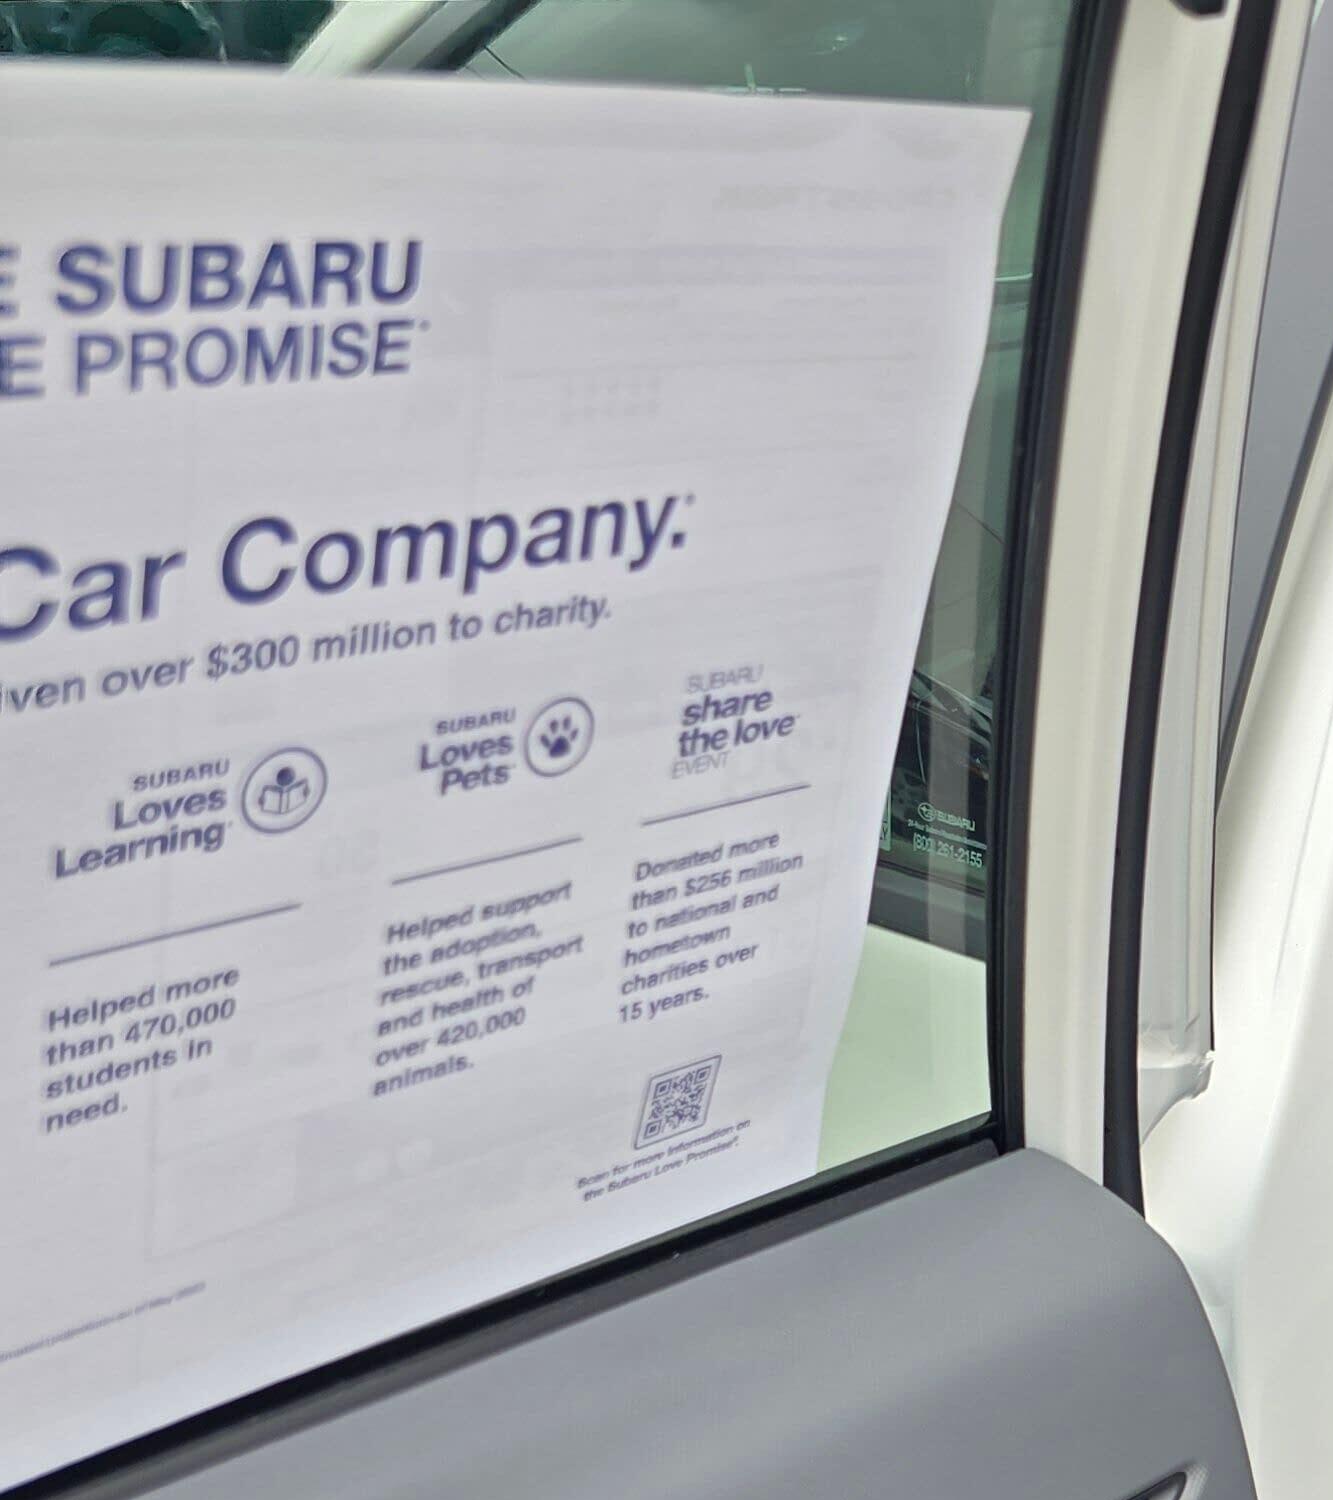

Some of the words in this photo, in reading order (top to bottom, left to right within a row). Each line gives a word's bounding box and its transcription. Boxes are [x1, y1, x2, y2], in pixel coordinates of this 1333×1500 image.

[56, 239, 423, 316] SUBARU
[75, 318, 415, 396] PROMISE
[0, 545, 187, 643] Car
[221, 497, 688, 605] Company.
[0, 676, 86, 714] ven
[102, 657, 194, 697] over
[207, 636, 301, 680] $300
[312, 618, 436, 661] million
[449, 610, 483, 642] to
[494, 596, 612, 635] charity.
[687, 665, 764, 694] SUBARU
[436, 708, 517, 736] SUBARU
[682, 690, 774, 727] share
[419, 734, 513, 772] Loves
[678, 727, 726, 758] the
[734, 714, 796, 747] love
[133, 758, 231, 793] SUBARU
[440, 764, 510, 796] Pets
[671, 751, 732, 780] EVENT
[113, 788, 227, 831] Loves
[55, 822, 226, 879] Learning
[636, 846, 725, 882] Donated
[728, 832, 780, 860] more
[632, 886, 678, 911] than
[737, 853, 804, 886] million
[387, 906, 474, 944] Helped
[481, 882, 573, 925] support
[627, 917, 648, 940] to
[654, 896, 737, 934] national
[742, 884, 780, 908] and
[381, 970, 470, 1006] rescue,
[479, 936, 584, 982] transport
[384, 952, 422, 976] the
[431, 922, 542, 965] adoption,
[621, 959, 709, 996] charities
[715, 943, 759, 970] over
[624, 924, 731, 968] hometown
[48, 985, 155, 1032] Helped
[166, 968, 240, 1002] more
[378, 1008, 424, 1037] and
[432, 986, 503, 1024] health
[511, 977, 535, 999] of
[619, 1003, 643, 1024] 15
[649, 986, 710, 1021] years.
[47, 1034, 115, 1066] than
[125, 998, 236, 1044] 470,000
[375, 1039, 430, 1067] over
[437, 1007, 526, 1048] 420,000
[46, 1049, 177, 1100] students
[187, 1036, 213, 1060] in
[373, 1056, 474, 1098] animals.
[46, 1093, 128, 1133] need.
[612, 1162, 632, 1176] for
[633, 1151, 665, 1169] more
[654, 1160, 683, 1177] Love
